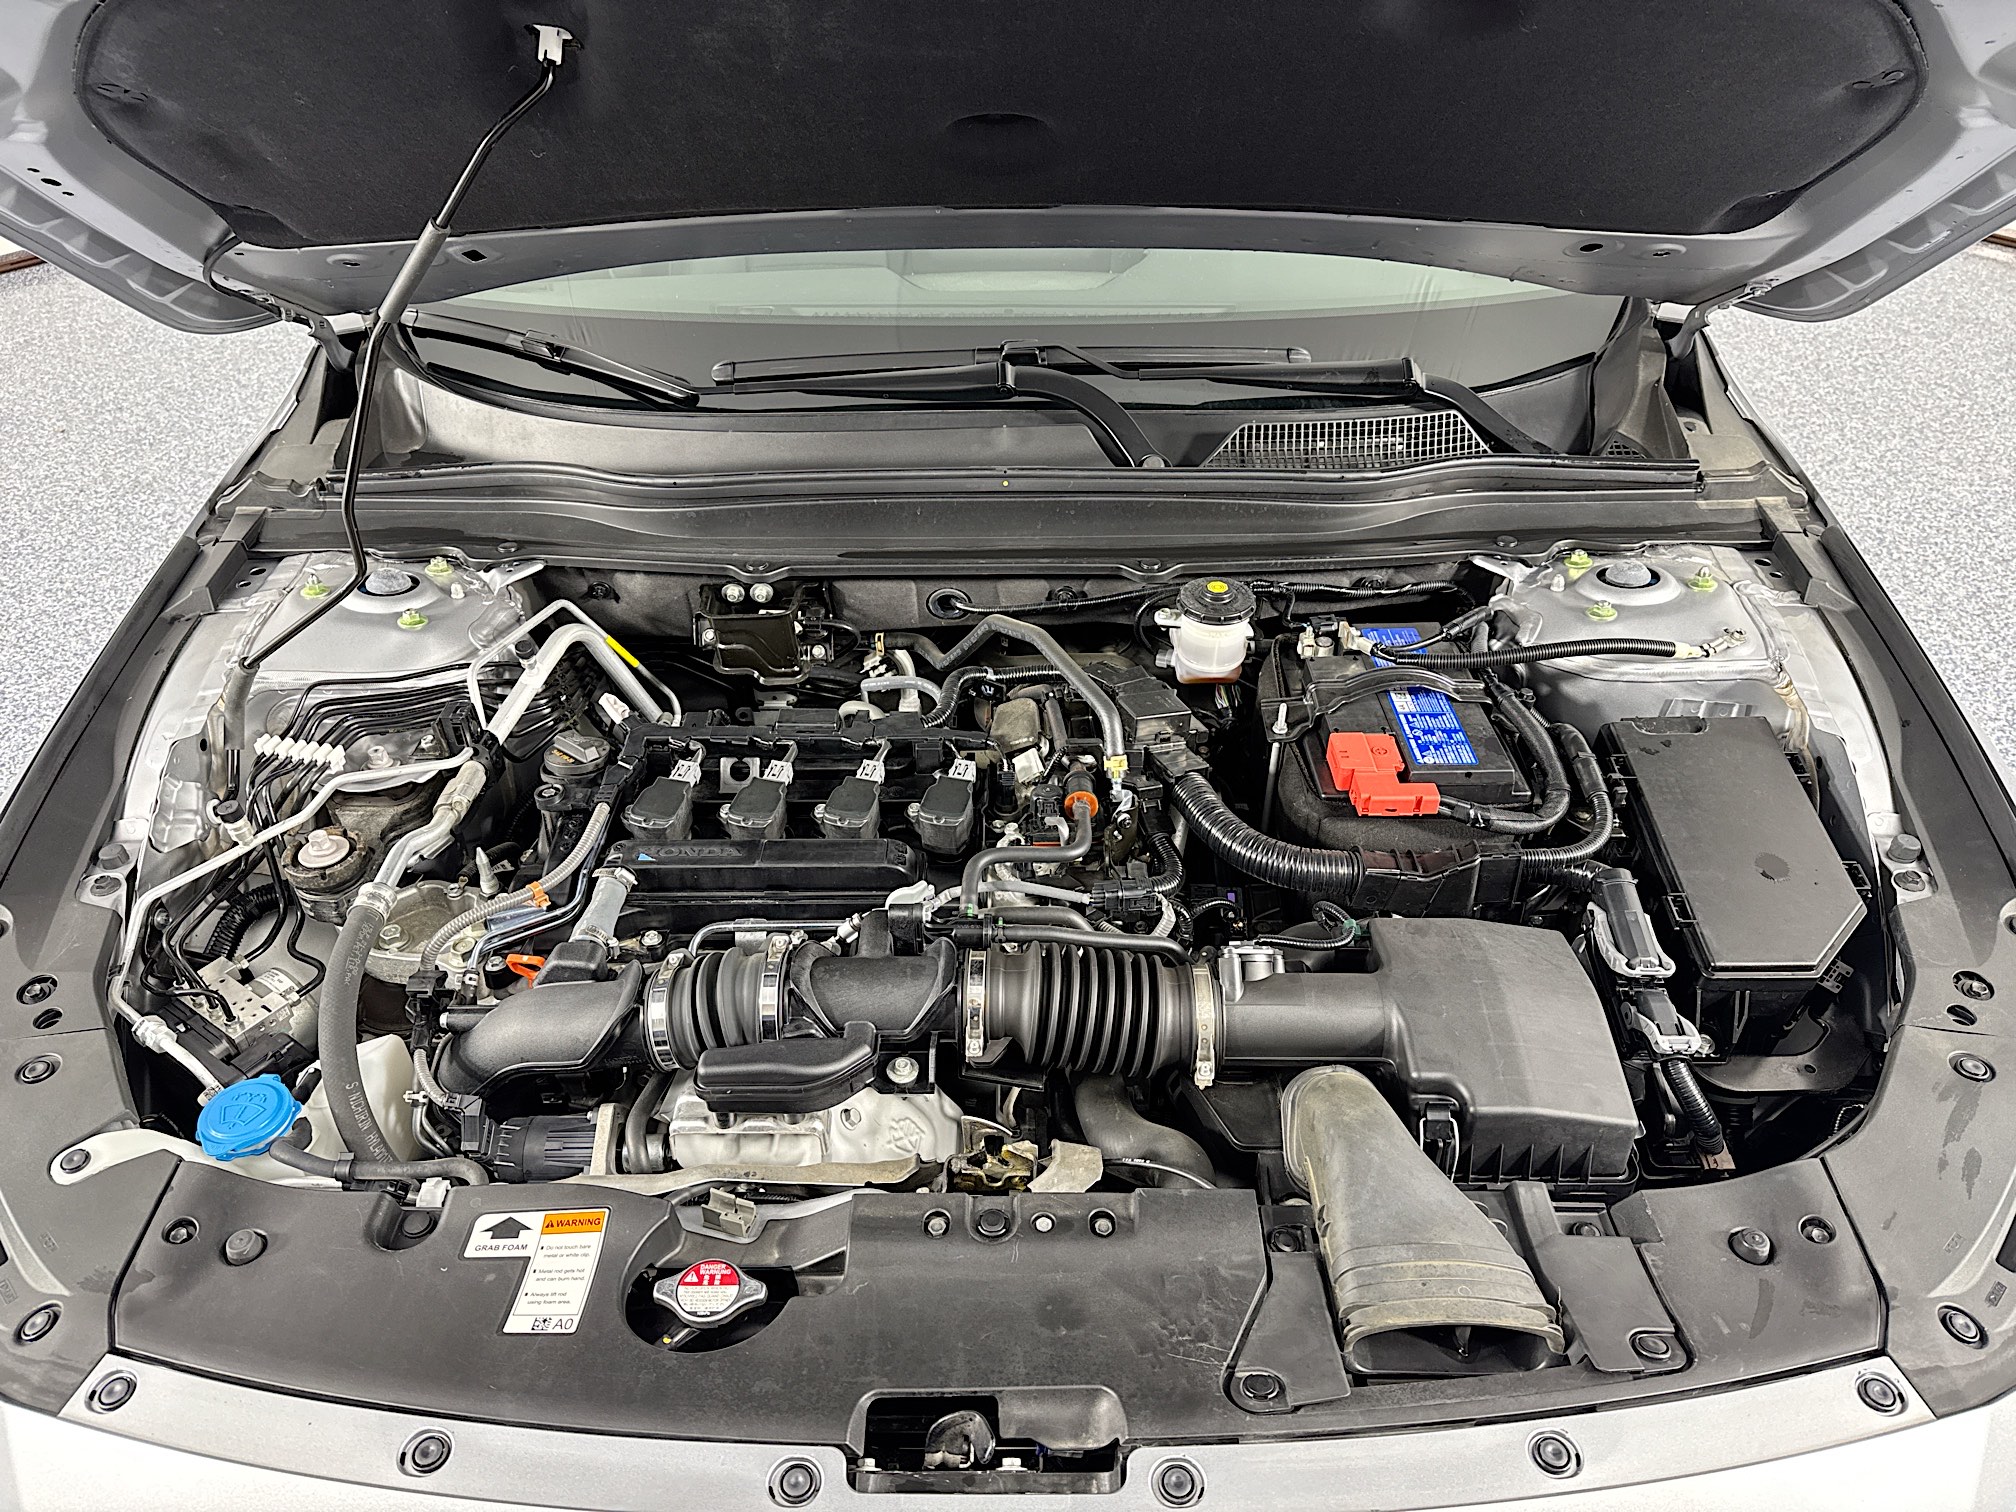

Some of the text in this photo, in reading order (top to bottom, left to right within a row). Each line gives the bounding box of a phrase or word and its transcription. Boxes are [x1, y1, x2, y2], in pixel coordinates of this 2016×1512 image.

[556, 1218, 601, 1228] WARNING
[474, 1244, 500, 1252] GRAB
[552, 1318, 574, 1330] A0
